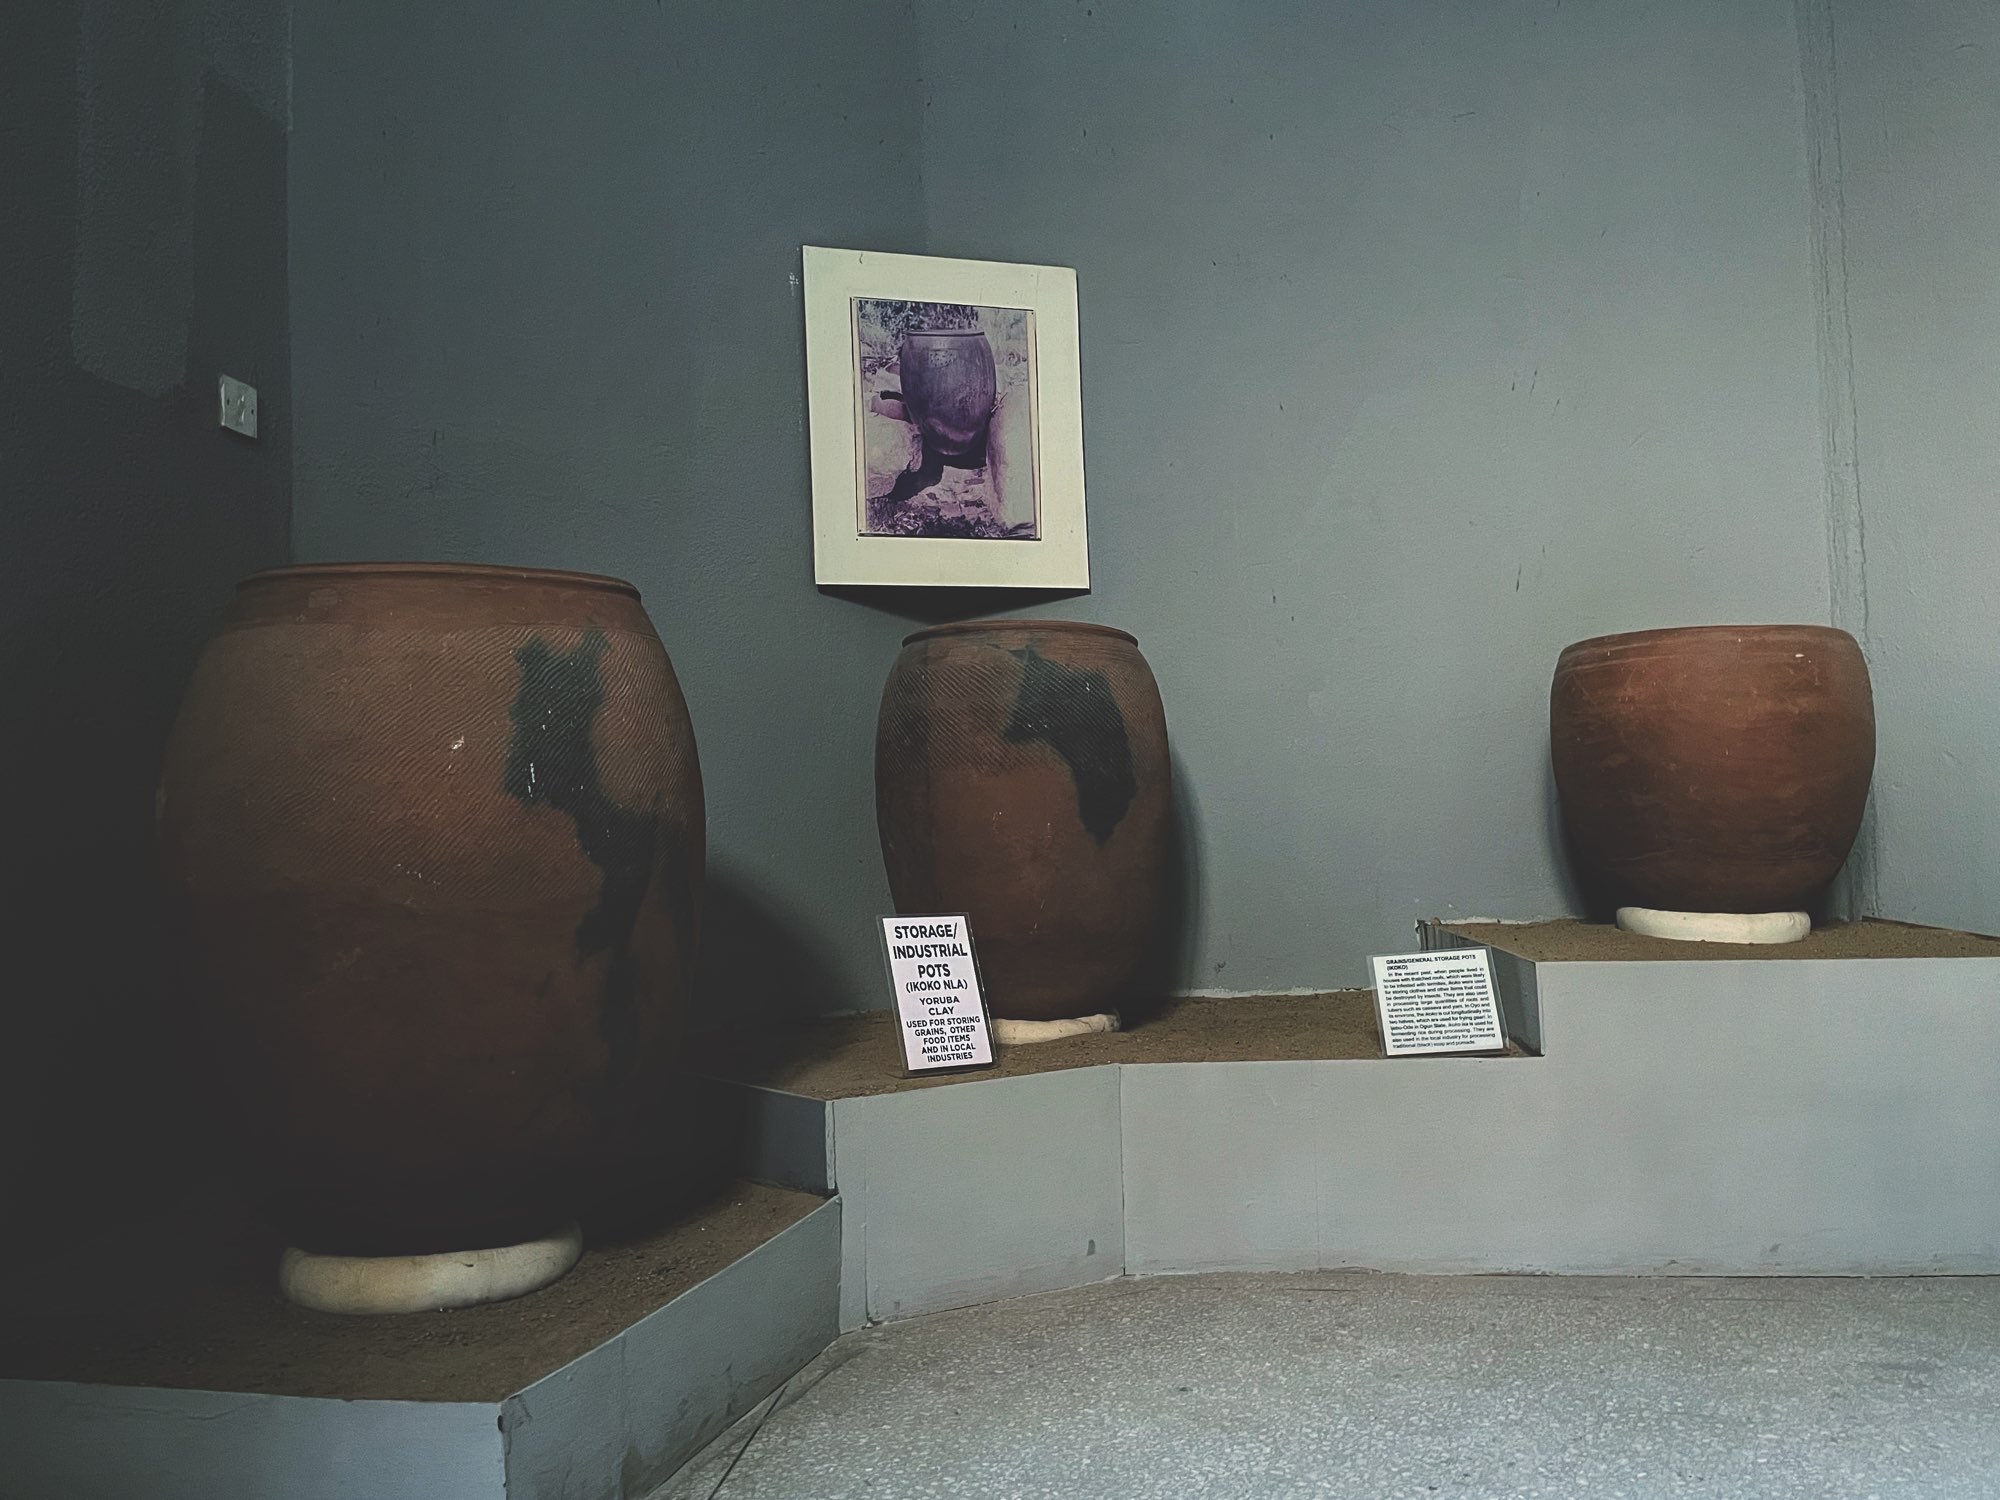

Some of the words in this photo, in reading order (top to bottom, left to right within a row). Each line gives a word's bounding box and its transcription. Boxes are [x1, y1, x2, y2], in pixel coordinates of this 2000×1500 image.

[895, 922, 958, 939] STORAGE/
[893, 943, 967, 959] INDUSTRIAL
[918, 964, 950, 978] POTS
[906, 981, 941, 993] (IKOKO
[944, 979, 968, 990] NLA)
[920, 996, 960, 1005] YORUBA
[928, 1006, 954, 1015] CLAY
[907, 1018, 927, 1028] USED
[929, 1018, 946, 1026] FOR
[947, 1016, 980, 1025] STORING
[915, 1028, 947, 1036] GRAINS,
[923, 1037, 946, 1045] FOOD
[922, 1045, 938, 1054] AND
[950, 1043, 976, 1052] LOCAL
[928, 1052, 973, 1062] INDUSTRIES
